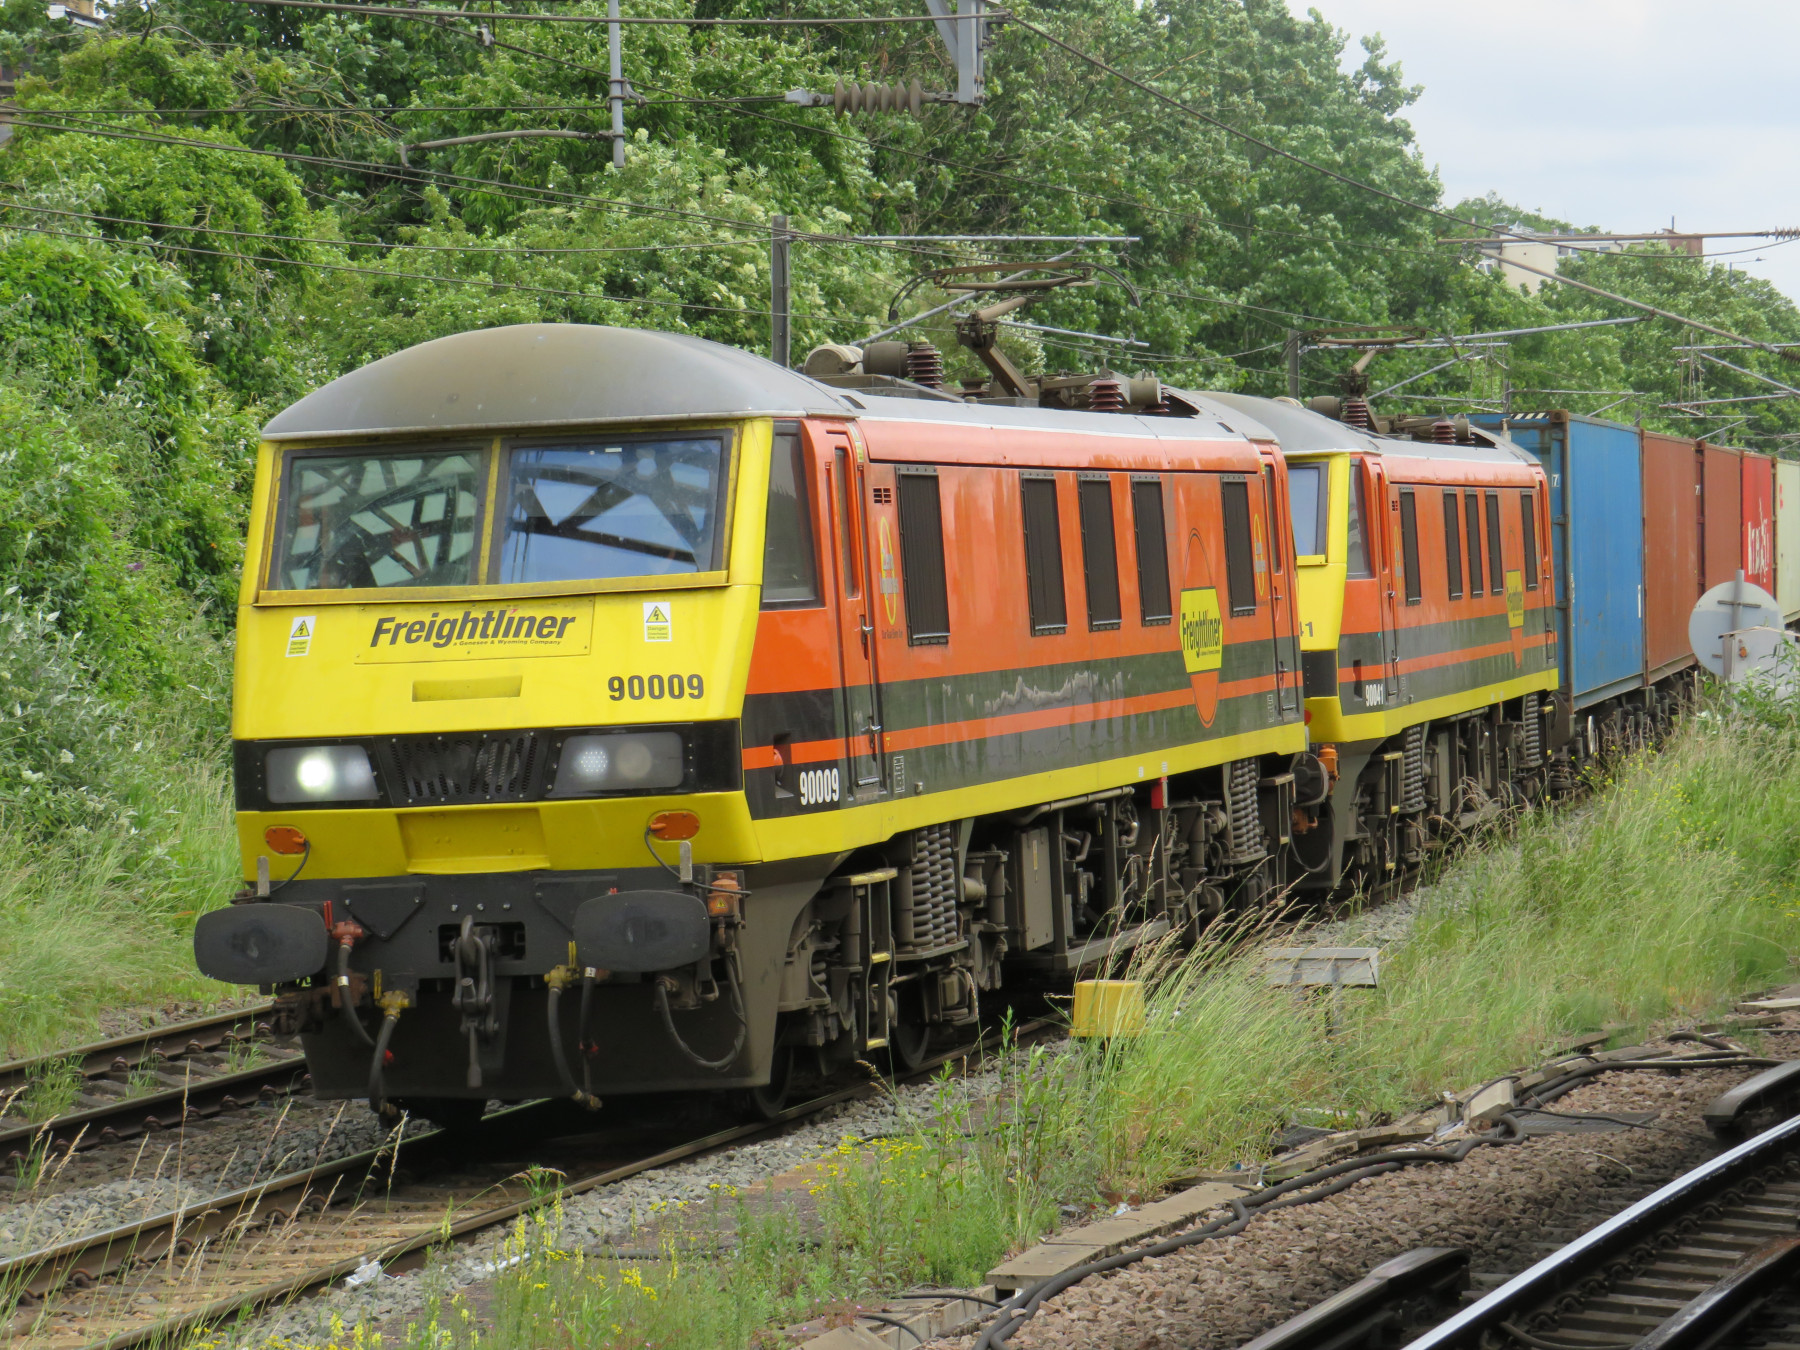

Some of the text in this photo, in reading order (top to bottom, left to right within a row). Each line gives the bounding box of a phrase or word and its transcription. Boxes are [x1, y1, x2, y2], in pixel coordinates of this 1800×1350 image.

[370, 609, 576, 648] Freightliner
[1182, 609, 1220, 658] Freightliner
[608, 674, 704, 701] 90009
[1365, 683, 1383, 707] 90041
[800, 768, 840, 806] 90009
